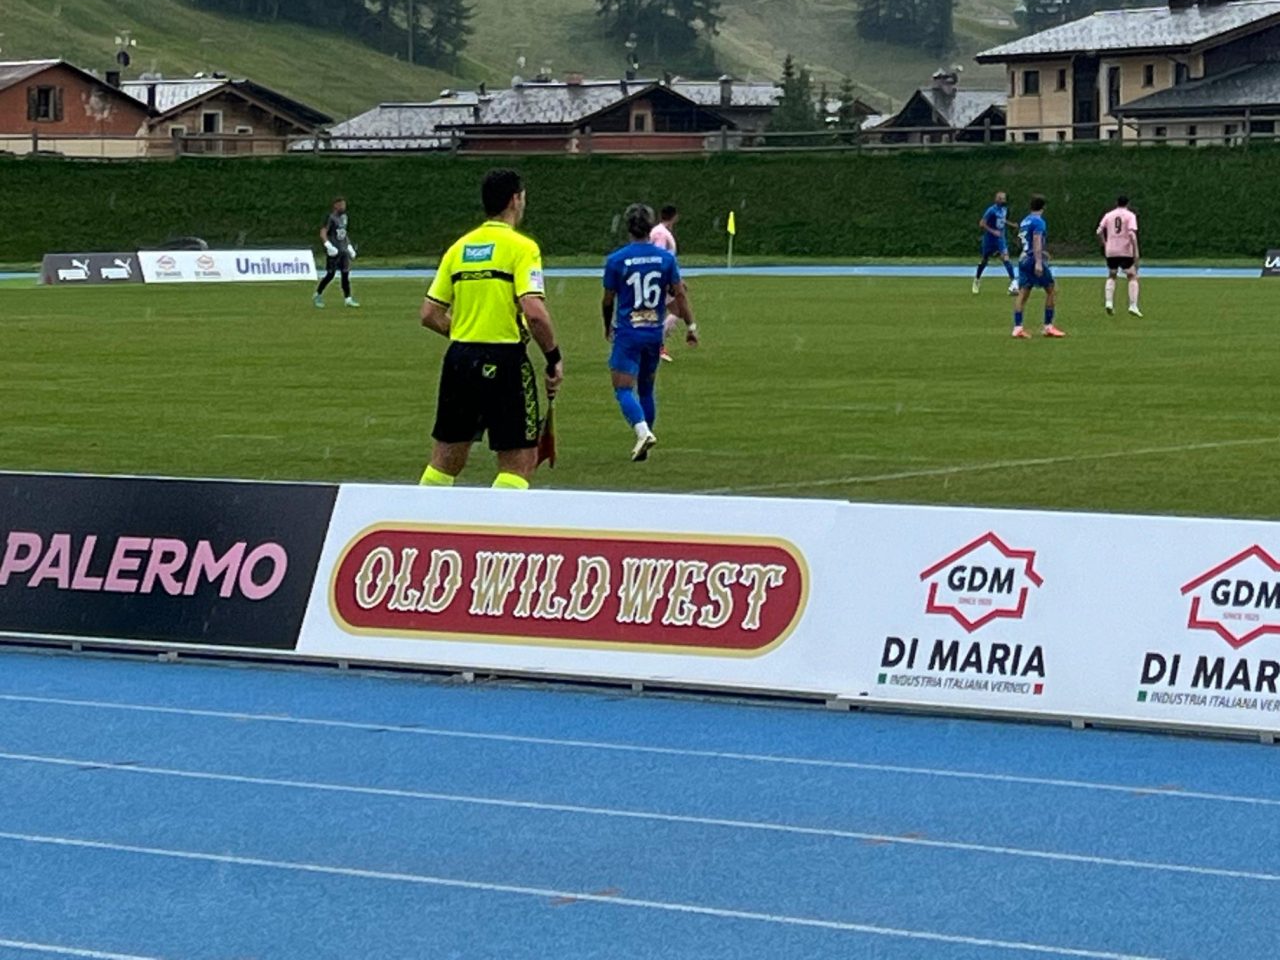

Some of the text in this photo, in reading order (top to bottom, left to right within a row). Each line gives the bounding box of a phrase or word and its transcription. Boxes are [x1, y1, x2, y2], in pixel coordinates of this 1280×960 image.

[236, 258, 310, 275] Unilumin
[626, 271, 661, 310] 16
[0, 531, 288, 600] PALERMO
[948, 565, 1015, 594] GDM
[355, 547, 787, 630] OLD WILD WEST
[881, 636, 1045, 678] DI MARIA
[1140, 652, 1181, 686] DI
[889, 674, 1031, 695] INDUSTRIA ITALIANA VERNICI
[1150, 691, 1207, 706] INDUSTRIA
[1208, 696, 1257, 710] ITALIANA
